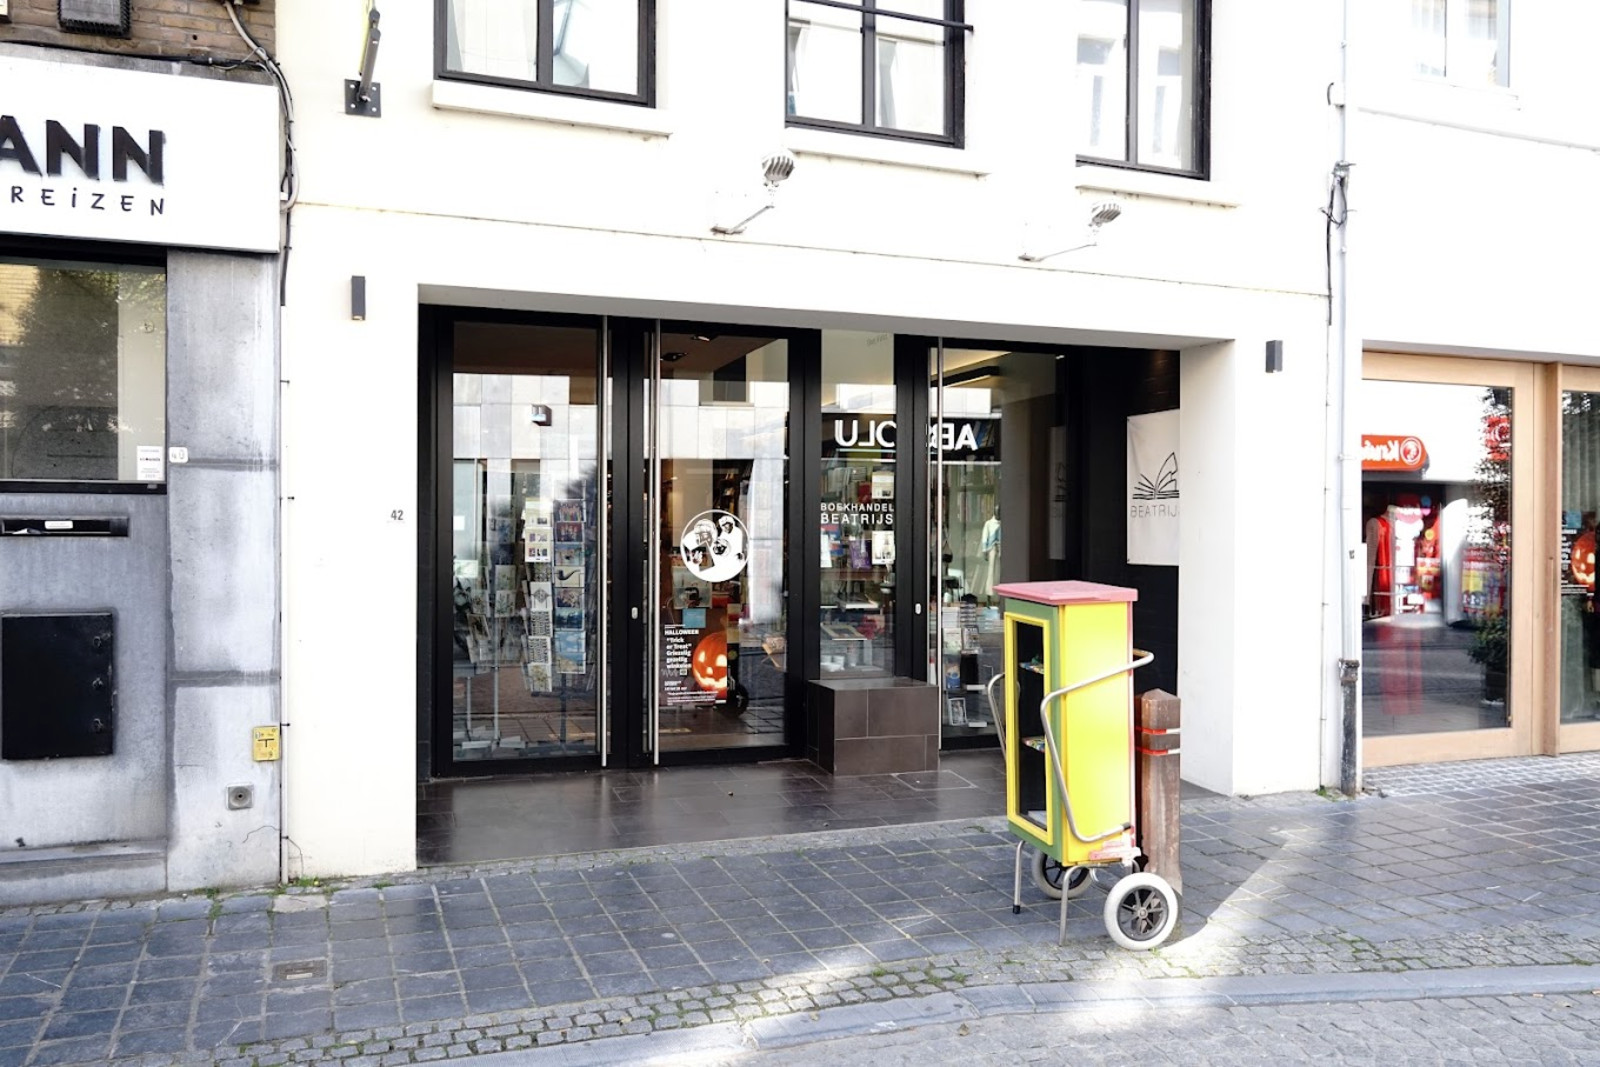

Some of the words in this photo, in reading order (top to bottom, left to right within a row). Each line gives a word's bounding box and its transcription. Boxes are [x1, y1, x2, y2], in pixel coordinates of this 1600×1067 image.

[820, 502, 895, 512] BOEKHANDEL
[1130, 504, 1180, 518] BEATRIJ
[390, 509, 404, 521] 42
[820, 513, 895, 525] BEATRIJS
